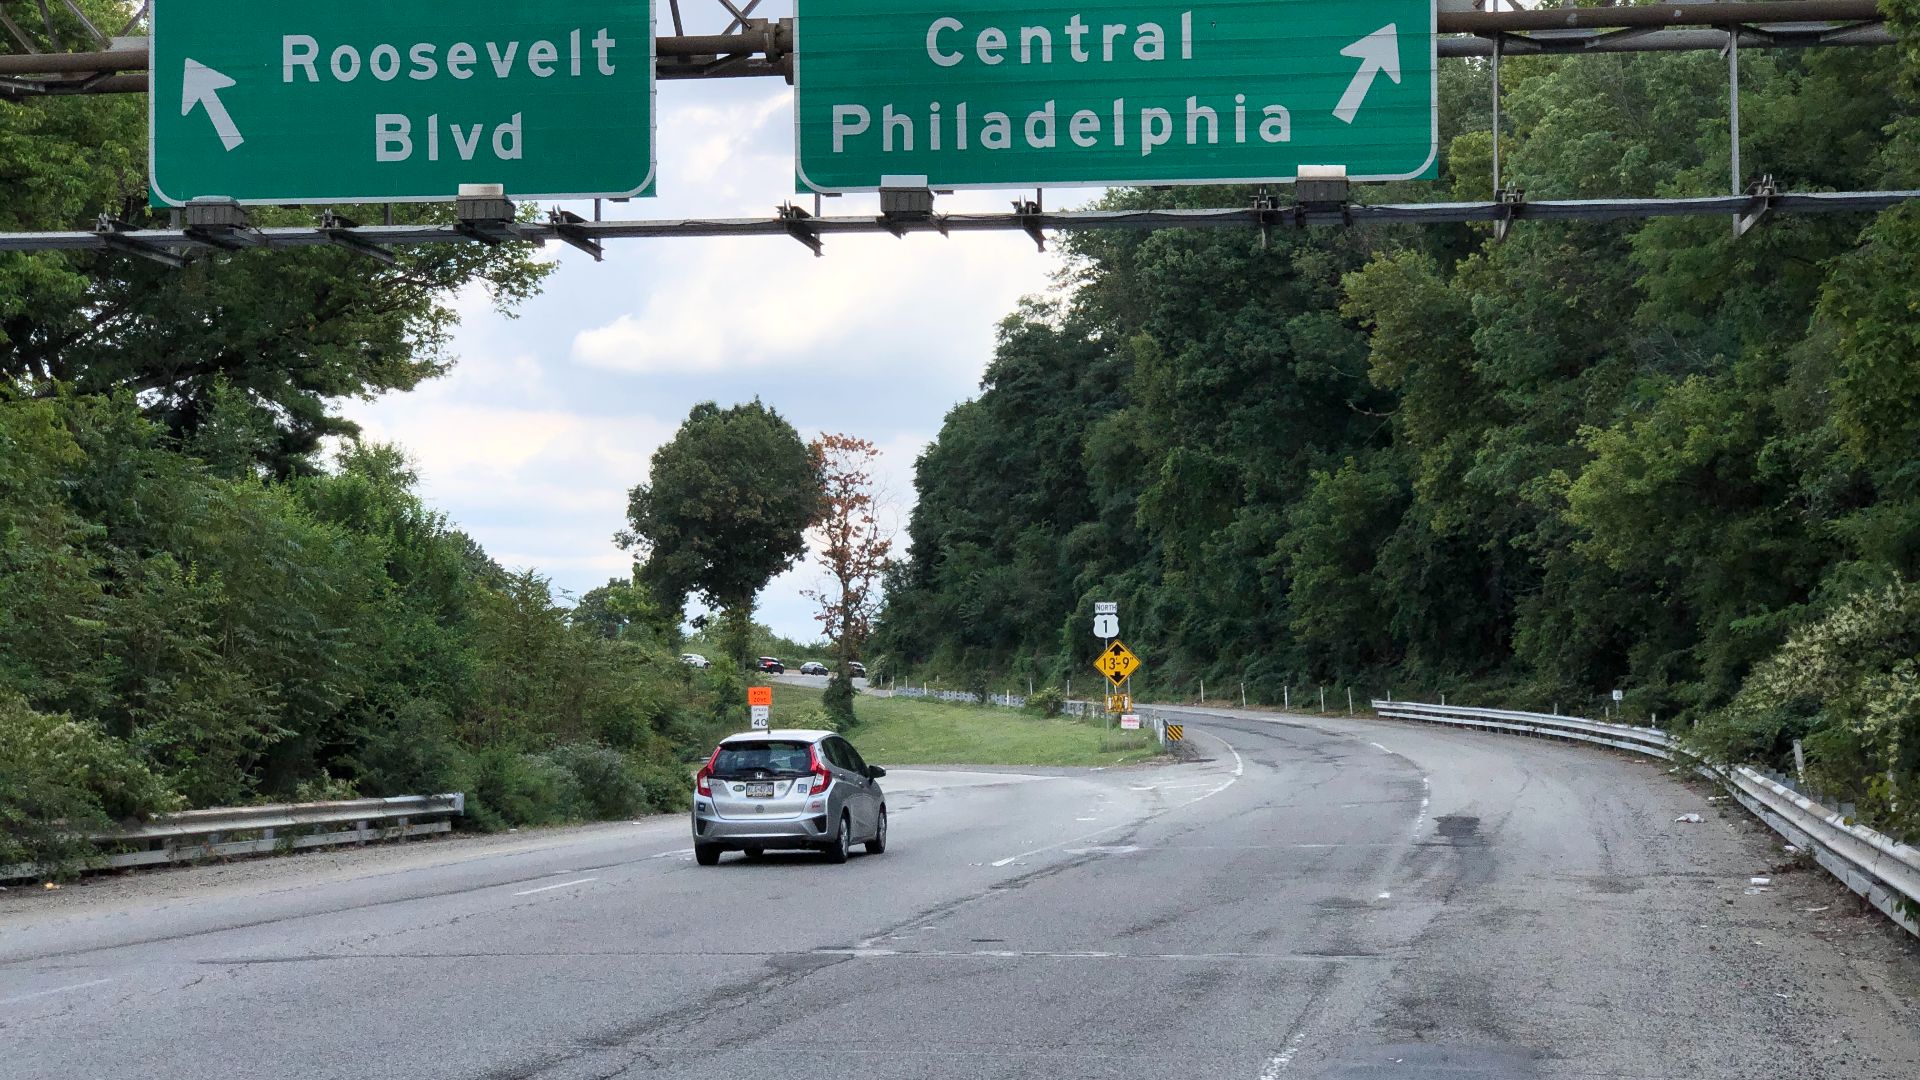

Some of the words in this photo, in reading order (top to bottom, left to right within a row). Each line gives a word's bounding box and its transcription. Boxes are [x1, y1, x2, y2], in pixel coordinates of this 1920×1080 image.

[282, 28, 617, 83] Roosevelt
[925, 11, 1193, 67] Central
[375, 112, 524, 163] Blvd
[832, 94, 1292, 157] Philadelphia
[1096, 603, 1117, 612] NORTH
[1102, 619, 1108, 634] 1
[753, 718, 767, 727] 40
